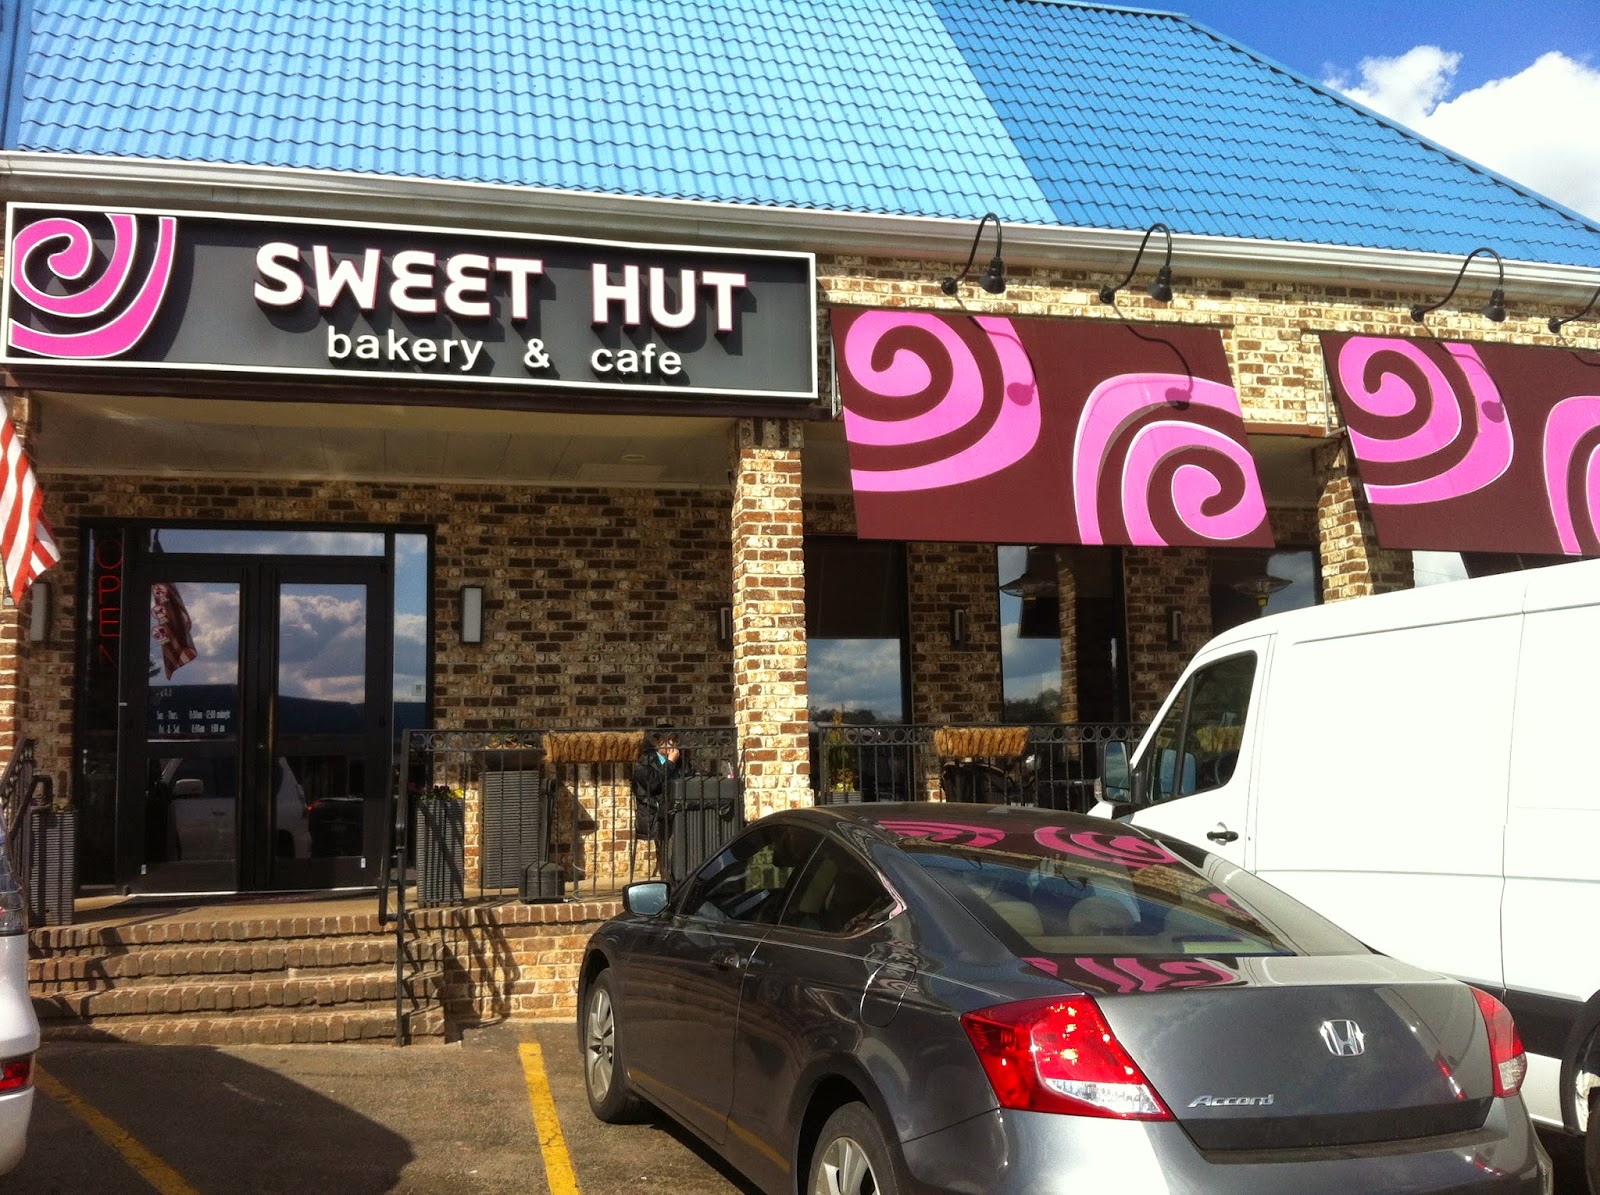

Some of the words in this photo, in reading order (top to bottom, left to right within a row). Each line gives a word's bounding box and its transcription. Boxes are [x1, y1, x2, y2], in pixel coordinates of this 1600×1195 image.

[253, 241, 544, 320] SWEET
[591, 262, 748, 332] HUT
[327, 325, 484, 371] bakery
[523, 338, 551, 369] &
[590, 343, 682, 375] cafe
[1187, 1093, 1274, 1108] Accord
